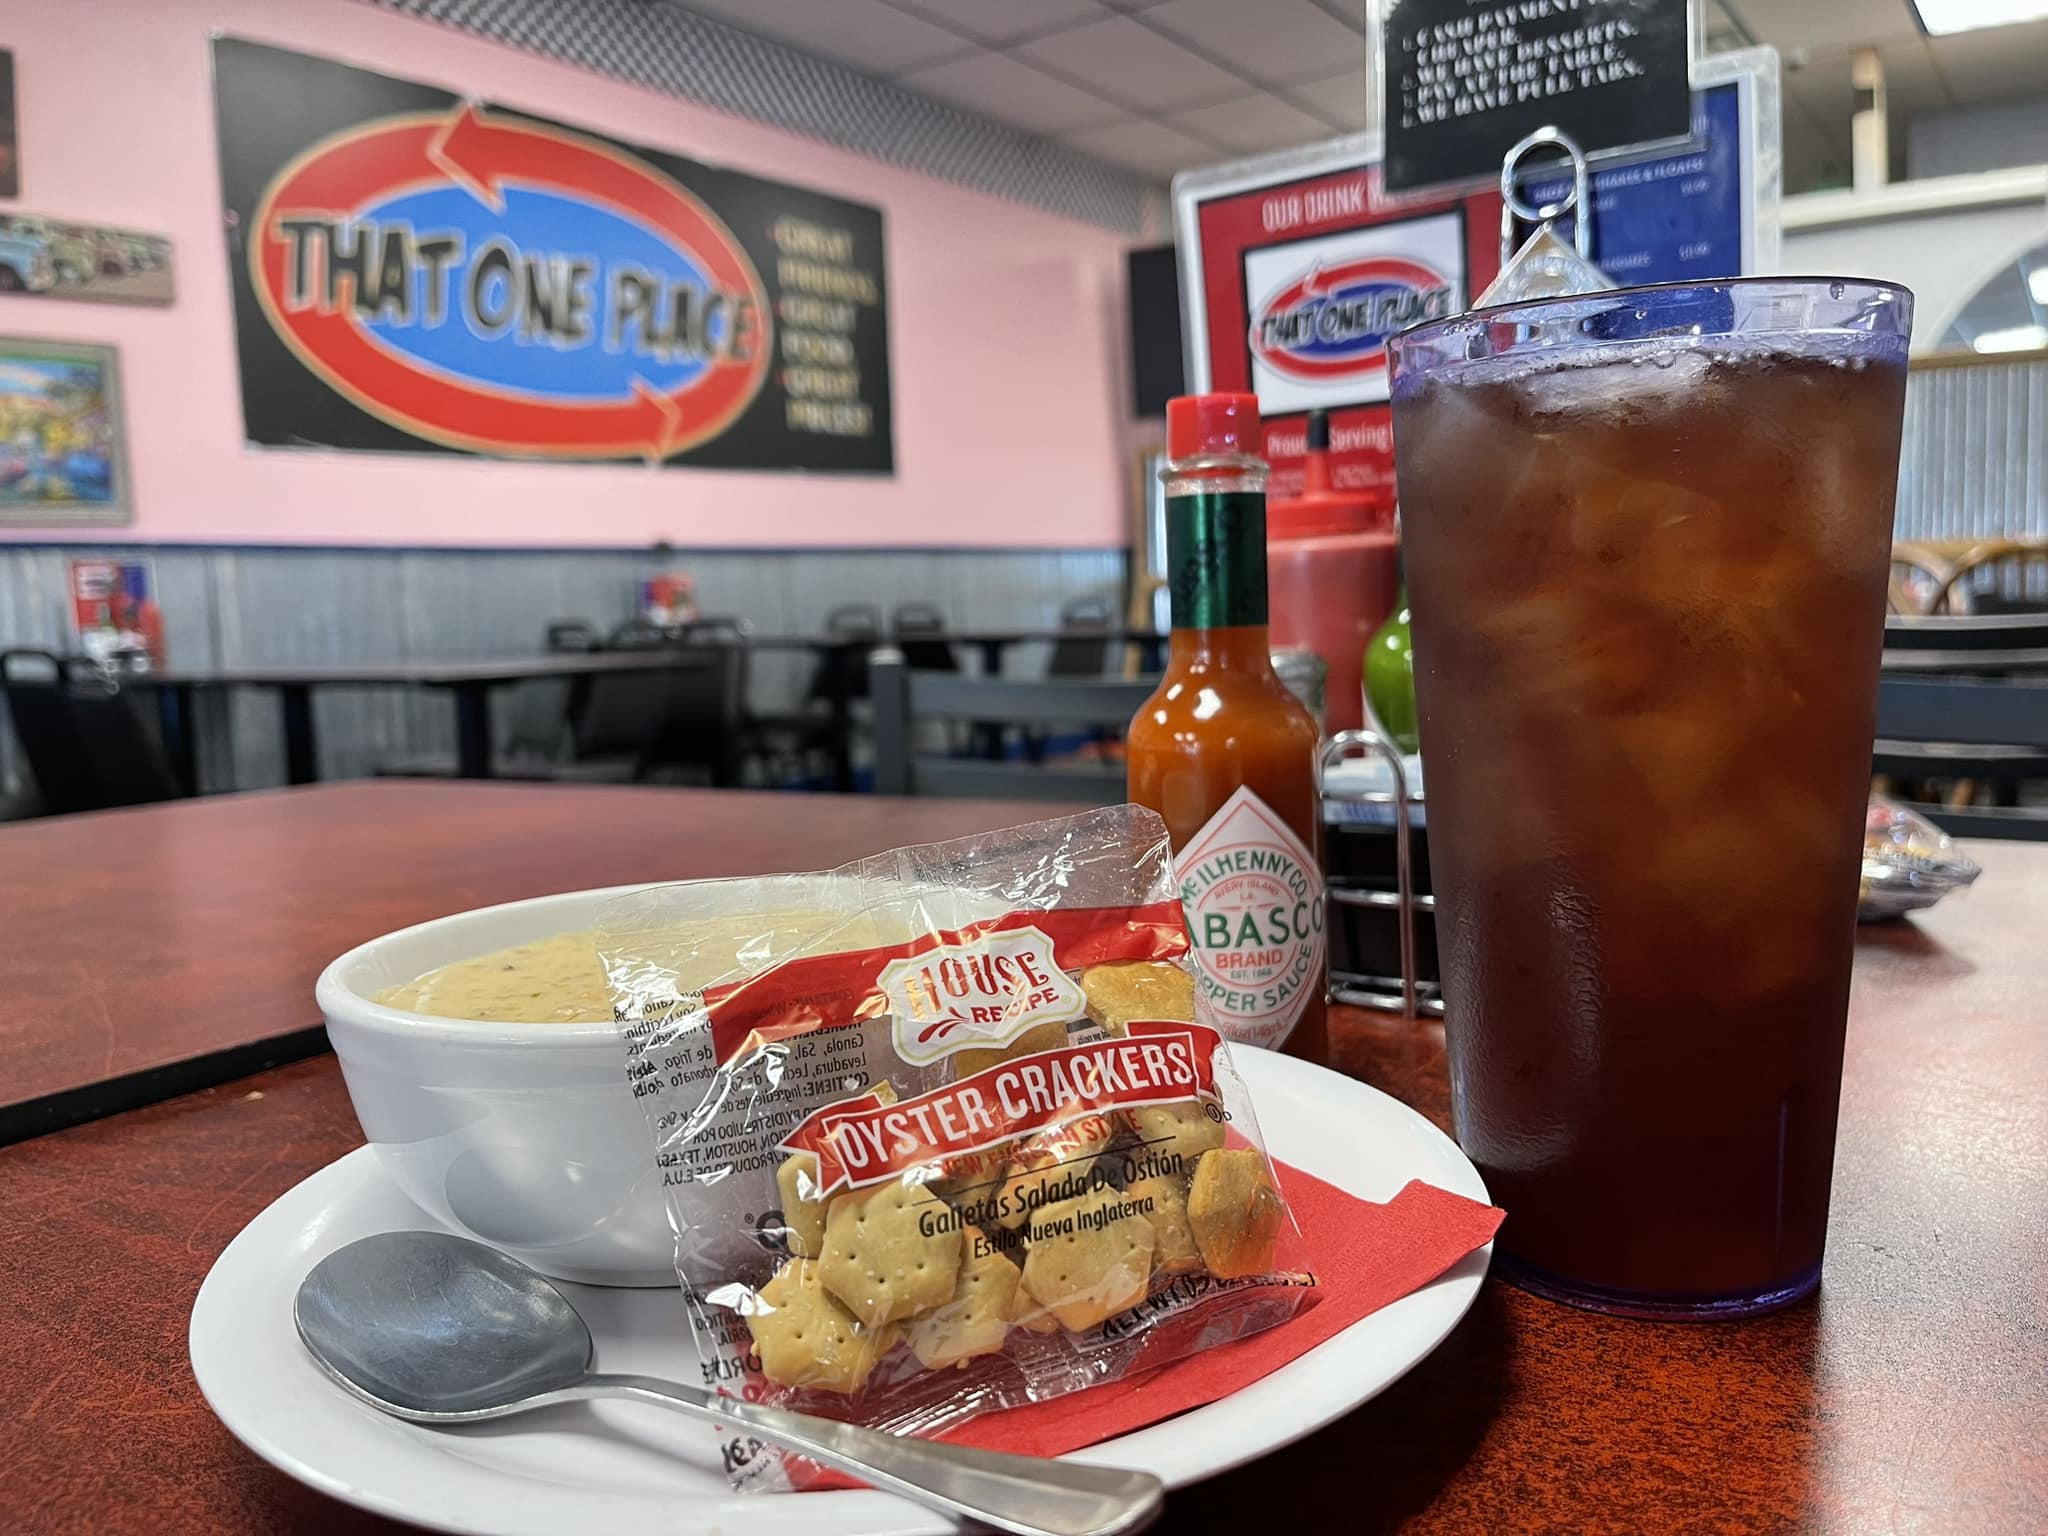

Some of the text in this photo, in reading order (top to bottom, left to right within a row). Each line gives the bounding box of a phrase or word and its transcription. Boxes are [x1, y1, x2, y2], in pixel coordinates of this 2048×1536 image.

[1417, 78, 1458, 105] PAY
[1454, 47, 1511, 78] HAVE
[1416, 99, 1450, 124] WE
[1454, 86, 1512, 116] HAVE
[1517, 70, 1575, 102] PULL
[1263, 195, 1301, 232] OUR
[1304, 181, 1367, 224] DRINK
[278, 217, 462, 327] THAT
[464, 241, 595, 349] ONE
[608, 267, 760, 367] PLACE
[1264, 285, 1456, 347] THAT ONE PLACE
[1184, 896, 1324, 949] BASCO
[904, 951, 1060, 1024] HOUSE RECIPE
[1216, 949, 1283, 969] BRAND
[1263, 943, 1313, 1008] SAUCE
[838, 1041, 1195, 1169] OYSTER CRACKERS
[919, 1150, 1184, 1239] Galletas Salada De Ostión
[974, 1196, 1155, 1262] Estilo Nueva Inglaterra
